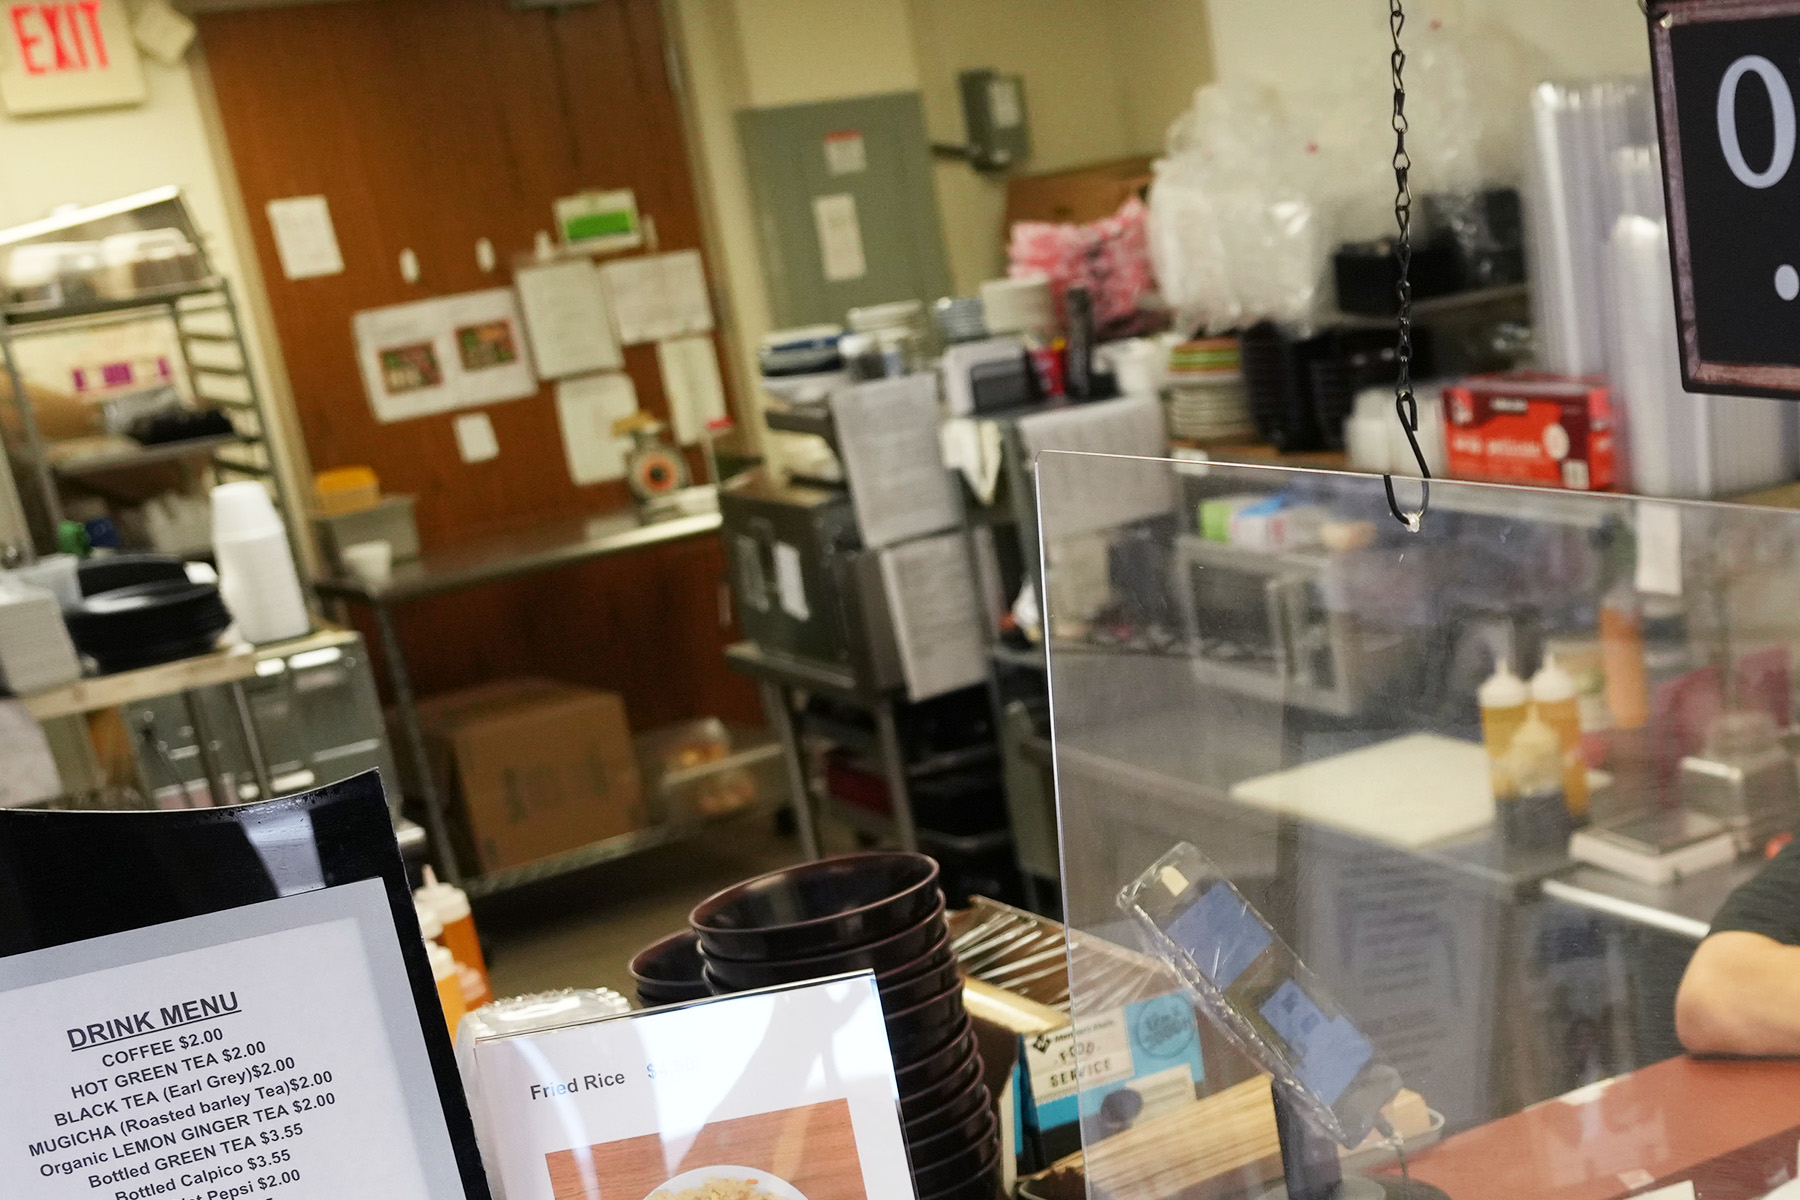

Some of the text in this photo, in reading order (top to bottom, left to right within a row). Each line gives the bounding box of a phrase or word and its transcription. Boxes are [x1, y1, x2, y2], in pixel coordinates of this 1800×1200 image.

[10, 0, 109, 75] EXIT
[66, 991, 238, 1048] DRINK MENU
[71, 1041, 266, 1099] HOT GREEN TEA $2.00
[102, 1028, 223, 1067] COFFEE $2.00
[1060, 1041, 1095, 1062] FOOD
[530, 1078, 579, 1100] Fried
[584, 1070, 625, 1091] Rice
[1050, 1058, 1112, 1087] SERVICE
[28, 1125, 116, 1157] MUGICHA
[120, 1104, 196, 1137] (Roasted
[199, 1093, 250, 1114] barley
[54, 1100, 119, 1127] BLACK
[121, 1091, 159, 1109] TEA
[163, 1079, 202, 1103] (Earl
[40, 1092, 335, 1177] Organic LEMON GINGER TEA $2.00
[88, 1123, 303, 1188] Bottled GREEN TEA $3.55
[180, 1164, 243, 1187] Calpico
[247, 1149, 291, 1171] $3.55
[257, 1169, 300, 1191] $2.00
